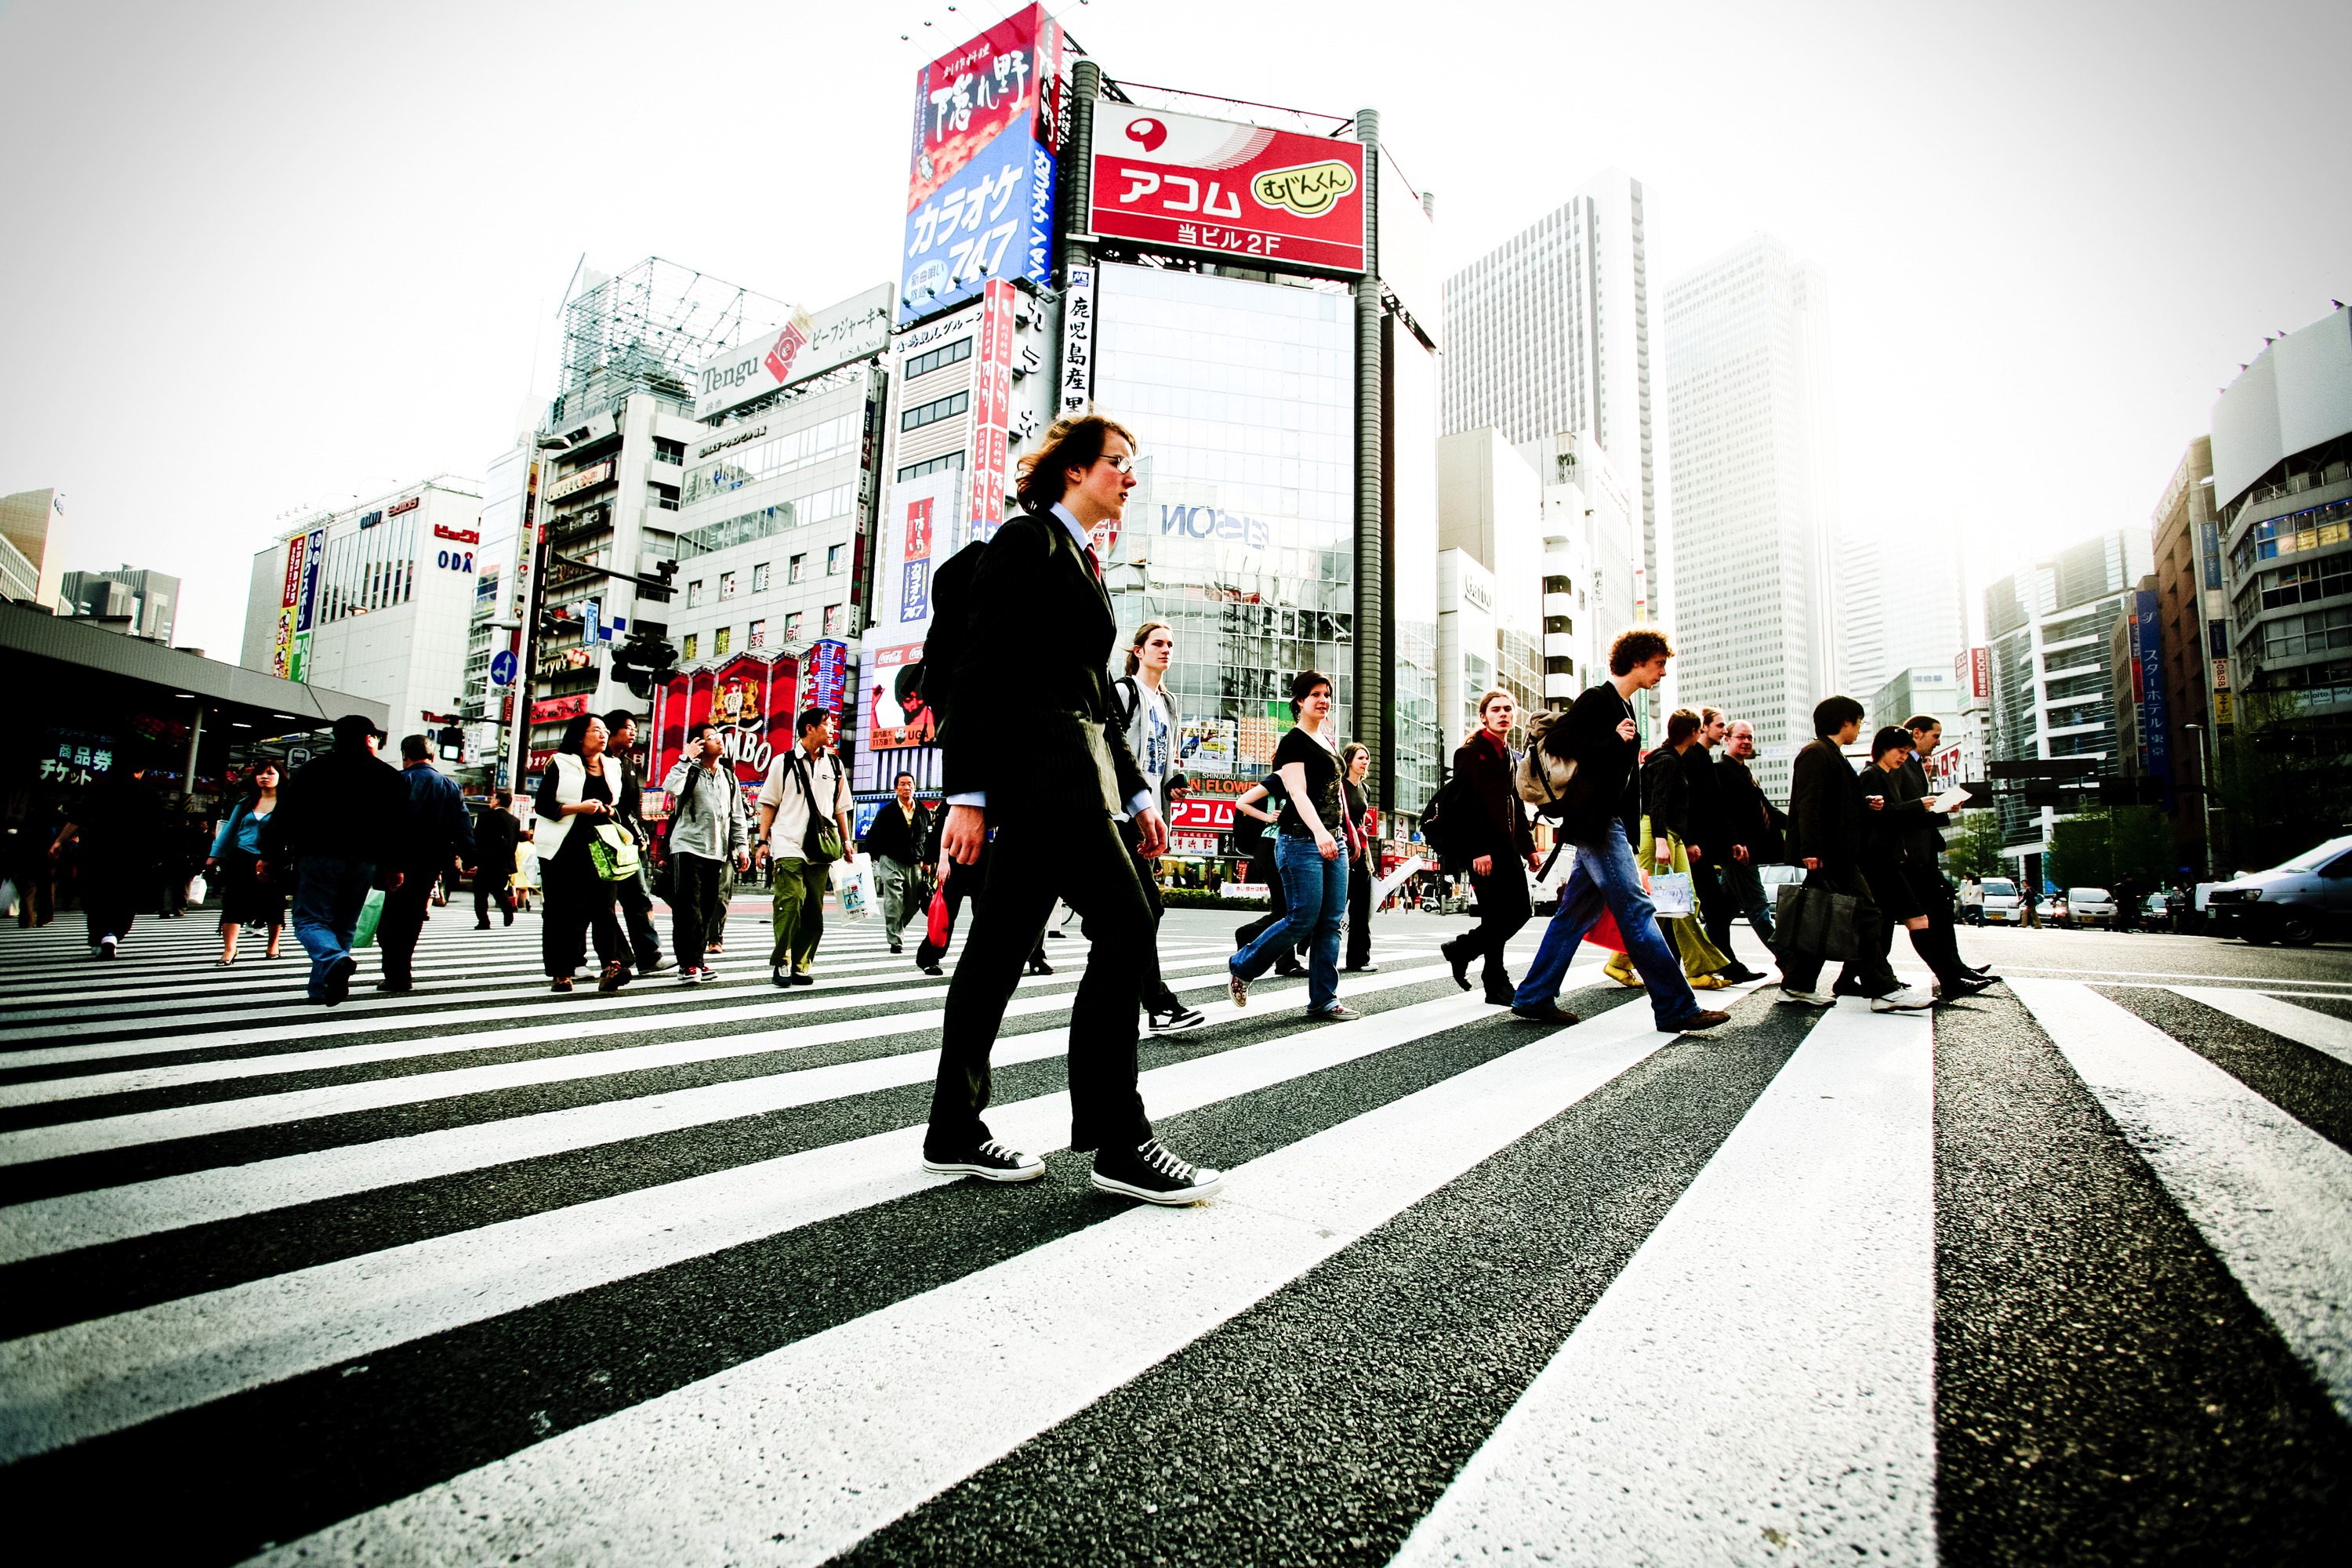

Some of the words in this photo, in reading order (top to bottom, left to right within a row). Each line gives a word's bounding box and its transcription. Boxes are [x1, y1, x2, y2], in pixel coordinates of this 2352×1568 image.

[942, 42, 990, 79] 創作料理
[930, 50, 1029, 143] 隠れ野
[1032, 149, 1051, 223] カラオケ
[1120, 168, 1242, 219] アコム
[1263, 170, 1347, 209] むじんくん
[908, 164, 1024, 259] カラオケ
[944, 219, 1019, 295] 747
[812, 307, 888, 350] ビーフジャーキー
[702, 356, 758, 395] Tengu
[909, 562, 923, 606] カラオケ
[1465, 573, 1492, 608] Garbo
[902, 604, 925, 620] 747
[2144, 649, 2163, 728] スターホテル
[2216, 664, 2227, 688] casa
[59, 743, 113, 772] 商品券
[2151, 734, 2165, 756] 東京
[39, 758, 93, 786] チケット
[1171, 803, 1234, 823] アコム
[1396, 829, 1407, 840] アコム
